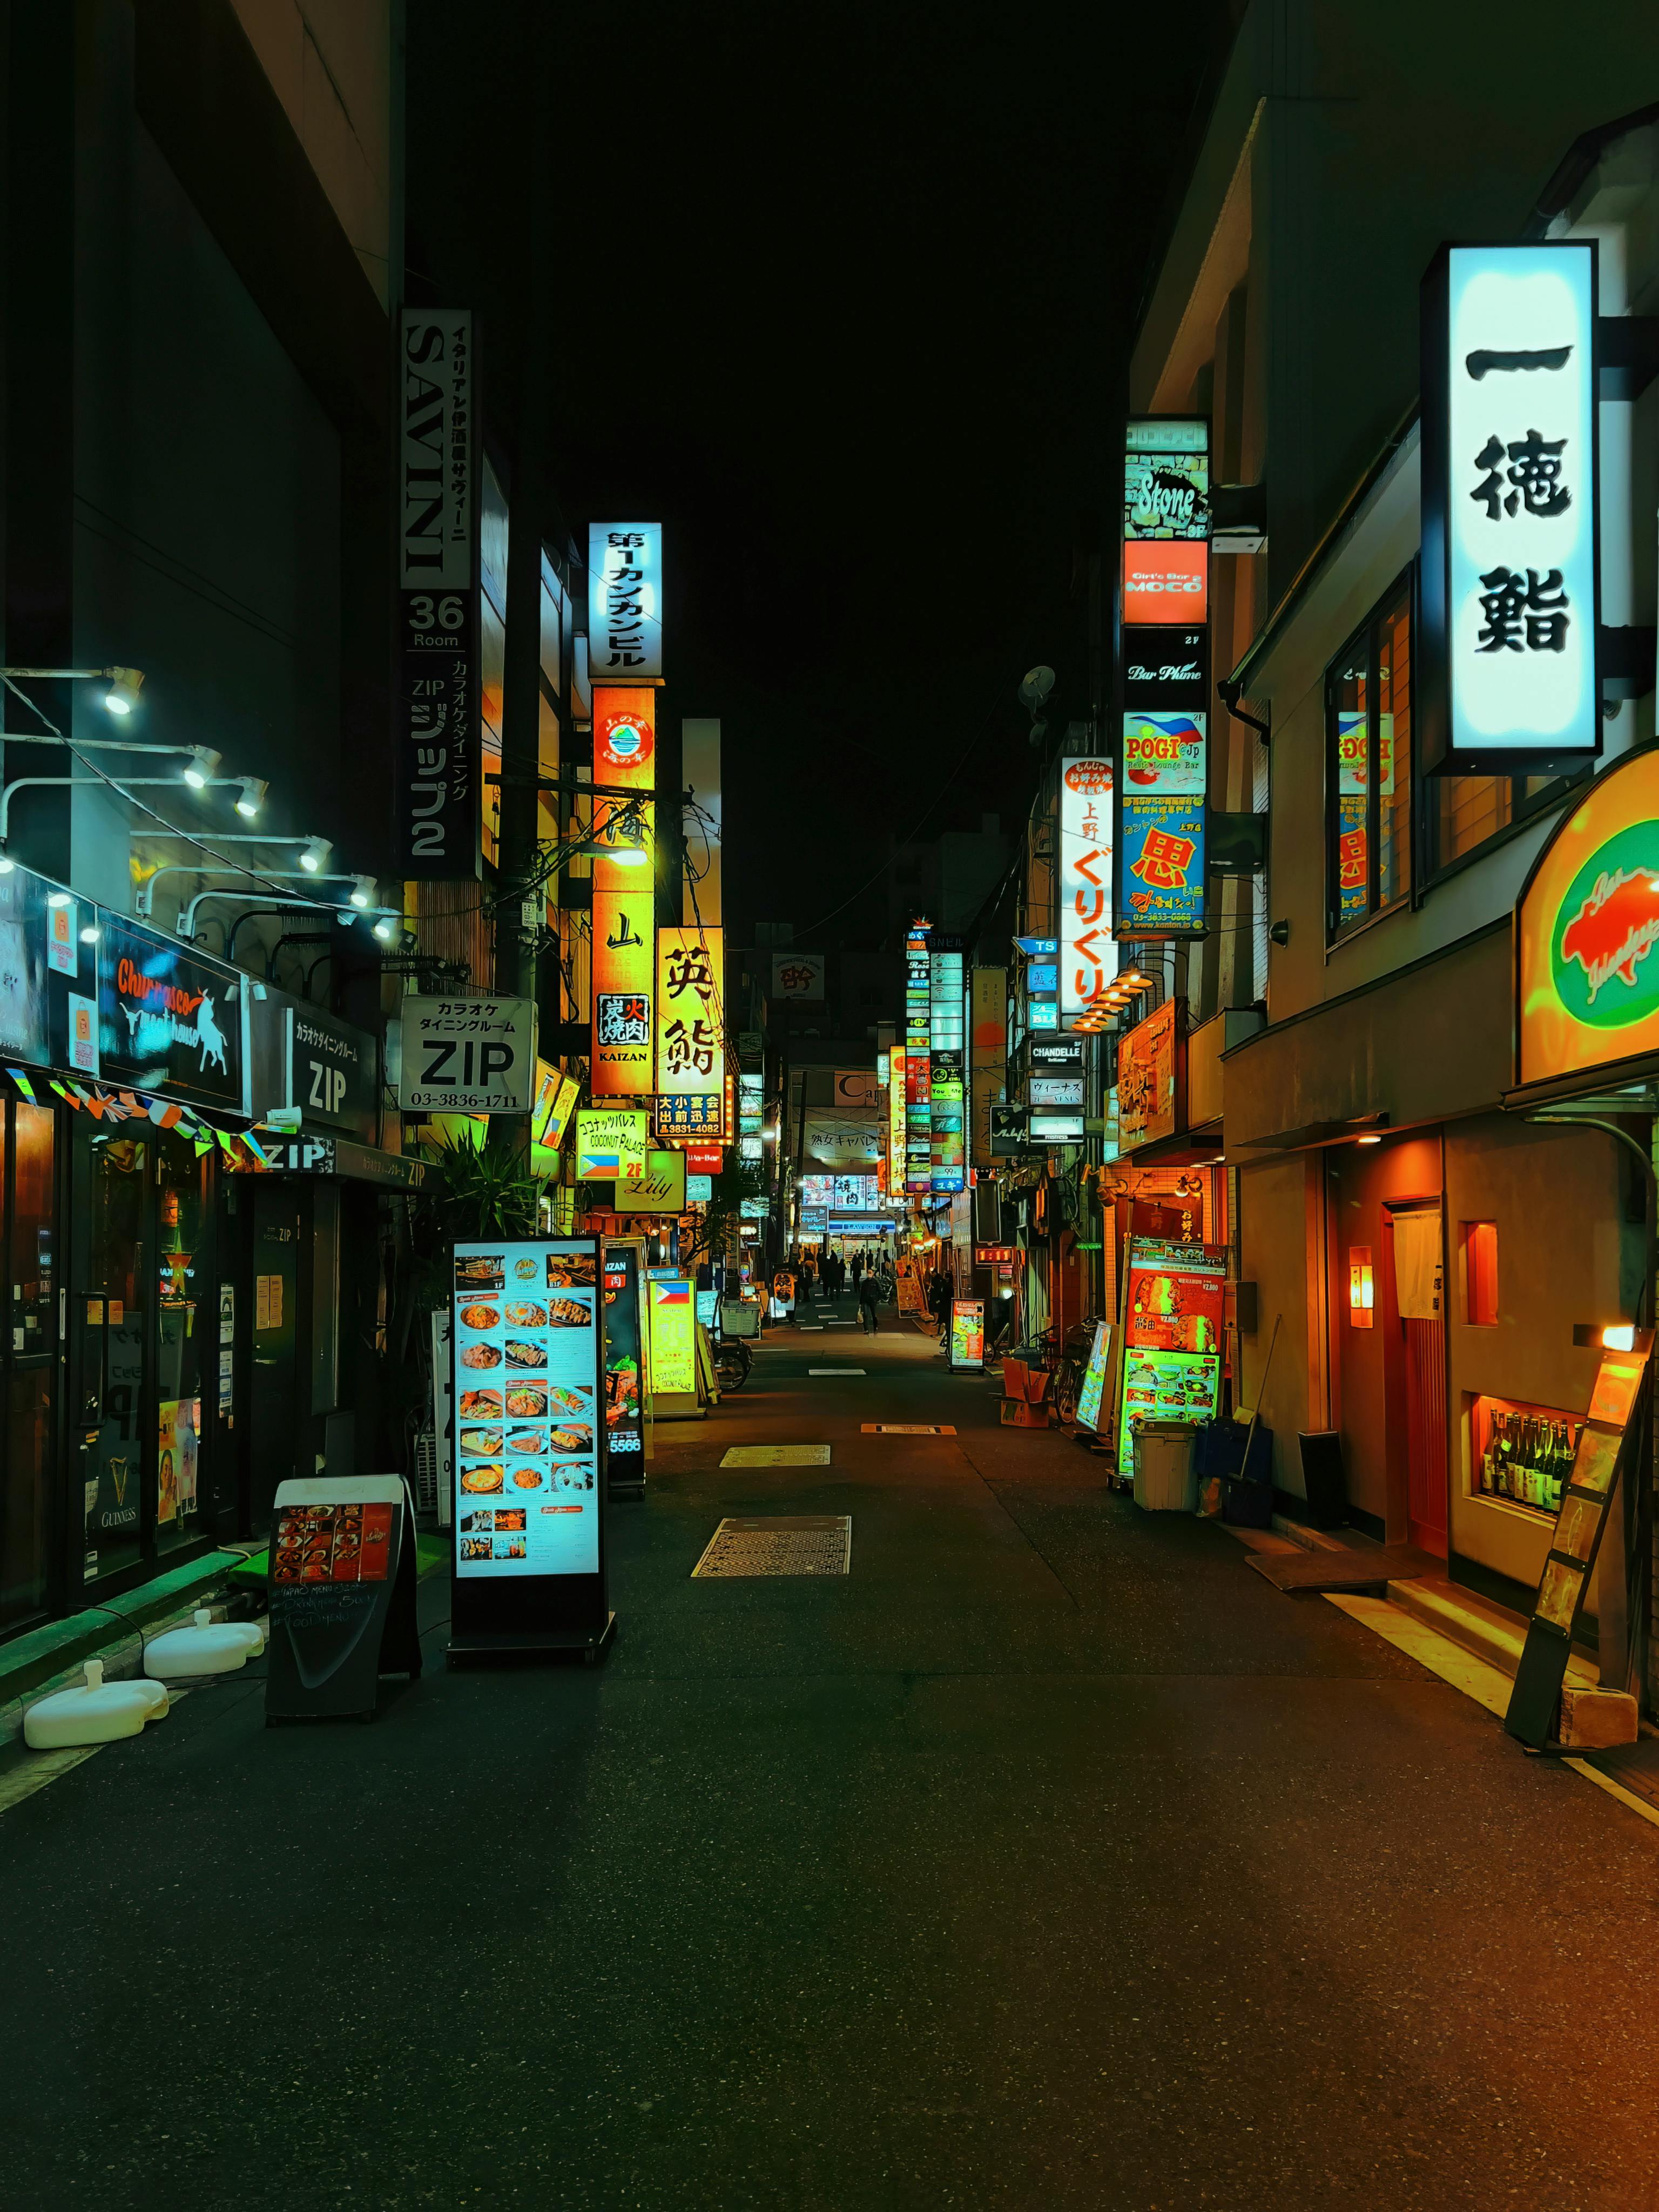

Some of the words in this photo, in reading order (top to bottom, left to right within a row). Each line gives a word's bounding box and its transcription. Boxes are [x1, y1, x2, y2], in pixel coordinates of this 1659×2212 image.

[406, 325, 444, 572] SAVINI
[1138, 471, 1195, 516] Stone
[1465, 345, 1574, 653] 一徳鮨
[1126, 582, 1202, 592] MOCO
[605, 532, 646, 667] 第1カンカンビル
[409, 596, 464, 630] 36
[414, 634, 458, 646] Room
[1128, 666, 1157, 680] Bar
[413, 680, 444, 695] ZIP
[453, 661, 468, 801] カラオケダイニング
[1126, 737, 1180, 760] POGI
[1069, 772, 1113, 785] お好み焼
[1082, 802, 1099, 841] 上野
[1073, 846, 1112, 1004] ぐりぐり
[1035, 941, 1055, 951] TS
[118, 958, 190, 1016] Churrasco
[438, 1002, 498, 1016] カラオケ
[665, 946, 714, 1076] 英鮨
[420, 1019, 516, 1033] ダイニングルーム
[296, 1022, 358, 1062] カラオケダイニングルーム
[599, 1053, 647, 1061] KAIZAN
[1033, 1048, 1080, 1057] CHANDELLE
[420, 1040, 515, 1086] ZIP
[309, 1061, 346, 1113] ZIP
[1033, 1083, 1081, 1092] ヴィーナス
[411, 1093, 519, 1107] 03-3836-1711
[659, 1096, 719, 1109] 大小宴会
[579, 1113, 636, 1135] ココナッツパレス
[660, 1111, 719, 1123] 出前迅速
[669, 1125, 719, 1133] 3831-4082
[590, 1135, 619, 1148] COCONUT
[262, 1145, 325, 1169] ZIP
[894, 1119, 906, 1182] 上野市場
[409, 1162, 425, 1186] ZIP
[626, 1163, 643, 1178] 2F
[624, 1173, 673, 1202] Lily
[279, 1228, 292, 1242] ZIP
[611, 1276, 622, 1287] 肉
[610, 1438, 641, 1453] 5566
